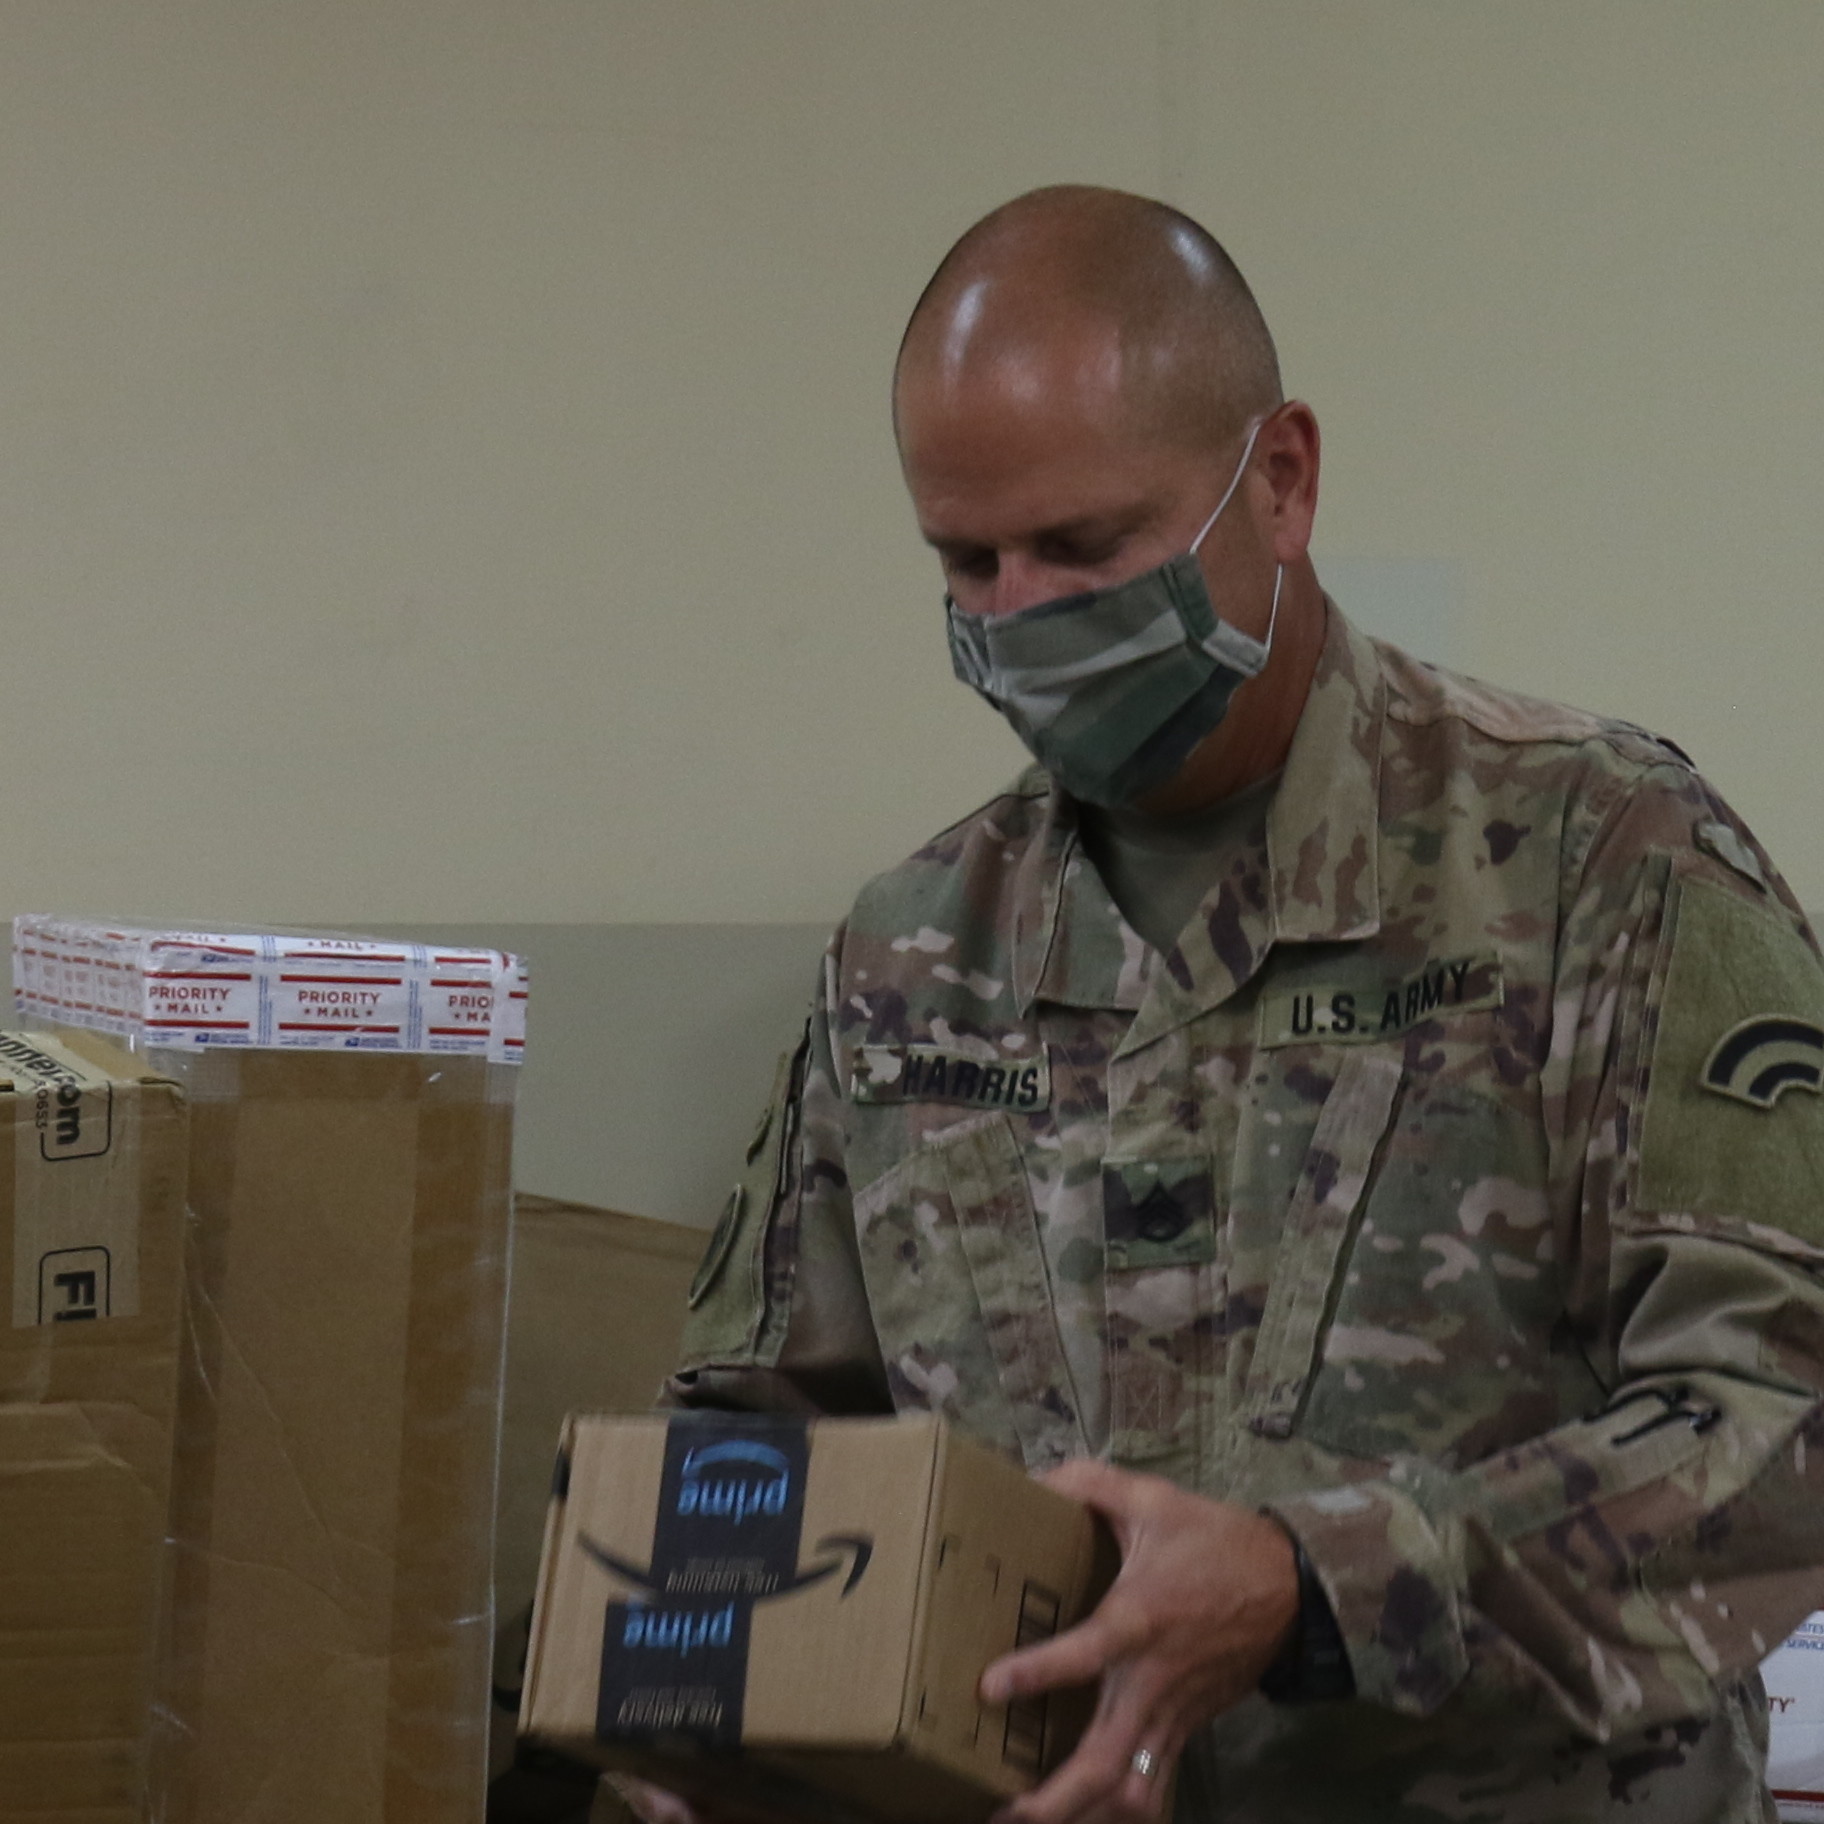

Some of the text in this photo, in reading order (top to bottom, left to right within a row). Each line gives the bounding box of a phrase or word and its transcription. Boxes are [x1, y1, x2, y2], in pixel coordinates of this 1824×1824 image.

[147, 985, 232, 1002] PRIORITY
[297, 989, 382, 1007] PRIORITY
[447, 994, 494, 1009] PRIO
[1291, 958, 1471, 1035] U.S. ARMY
[166, 1002, 210, 1015] MAIL
[316, 1006, 360, 1019] MAIL
[902, 1054, 1040, 1107] HARRIS
[676, 1466, 791, 1527] prime
[622, 1600, 735, 1659] prime
